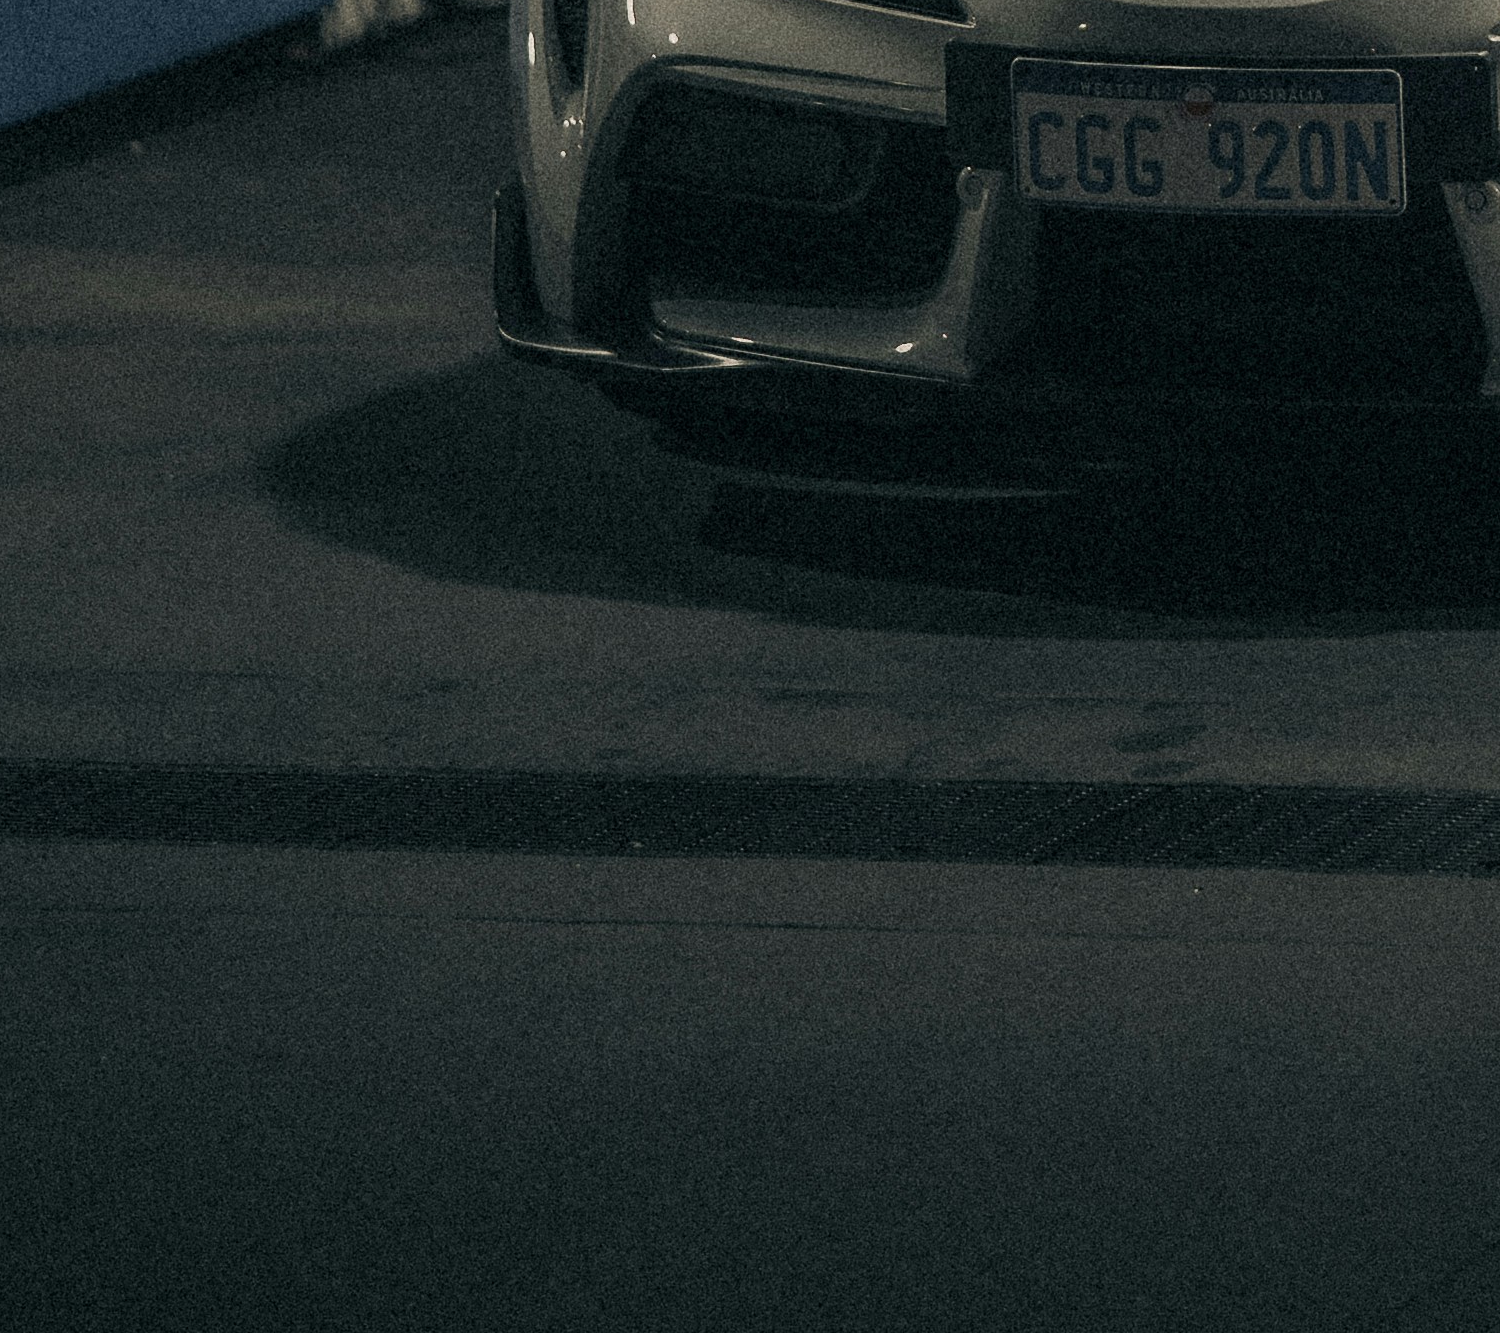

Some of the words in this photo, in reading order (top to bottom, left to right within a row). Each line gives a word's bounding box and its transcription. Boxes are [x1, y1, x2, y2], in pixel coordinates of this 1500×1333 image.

[1237, 86, 1325, 102] AUSTRALIA
[1028, 110, 1163, 197] CGG
[1207, 120, 1390, 203] 920N
